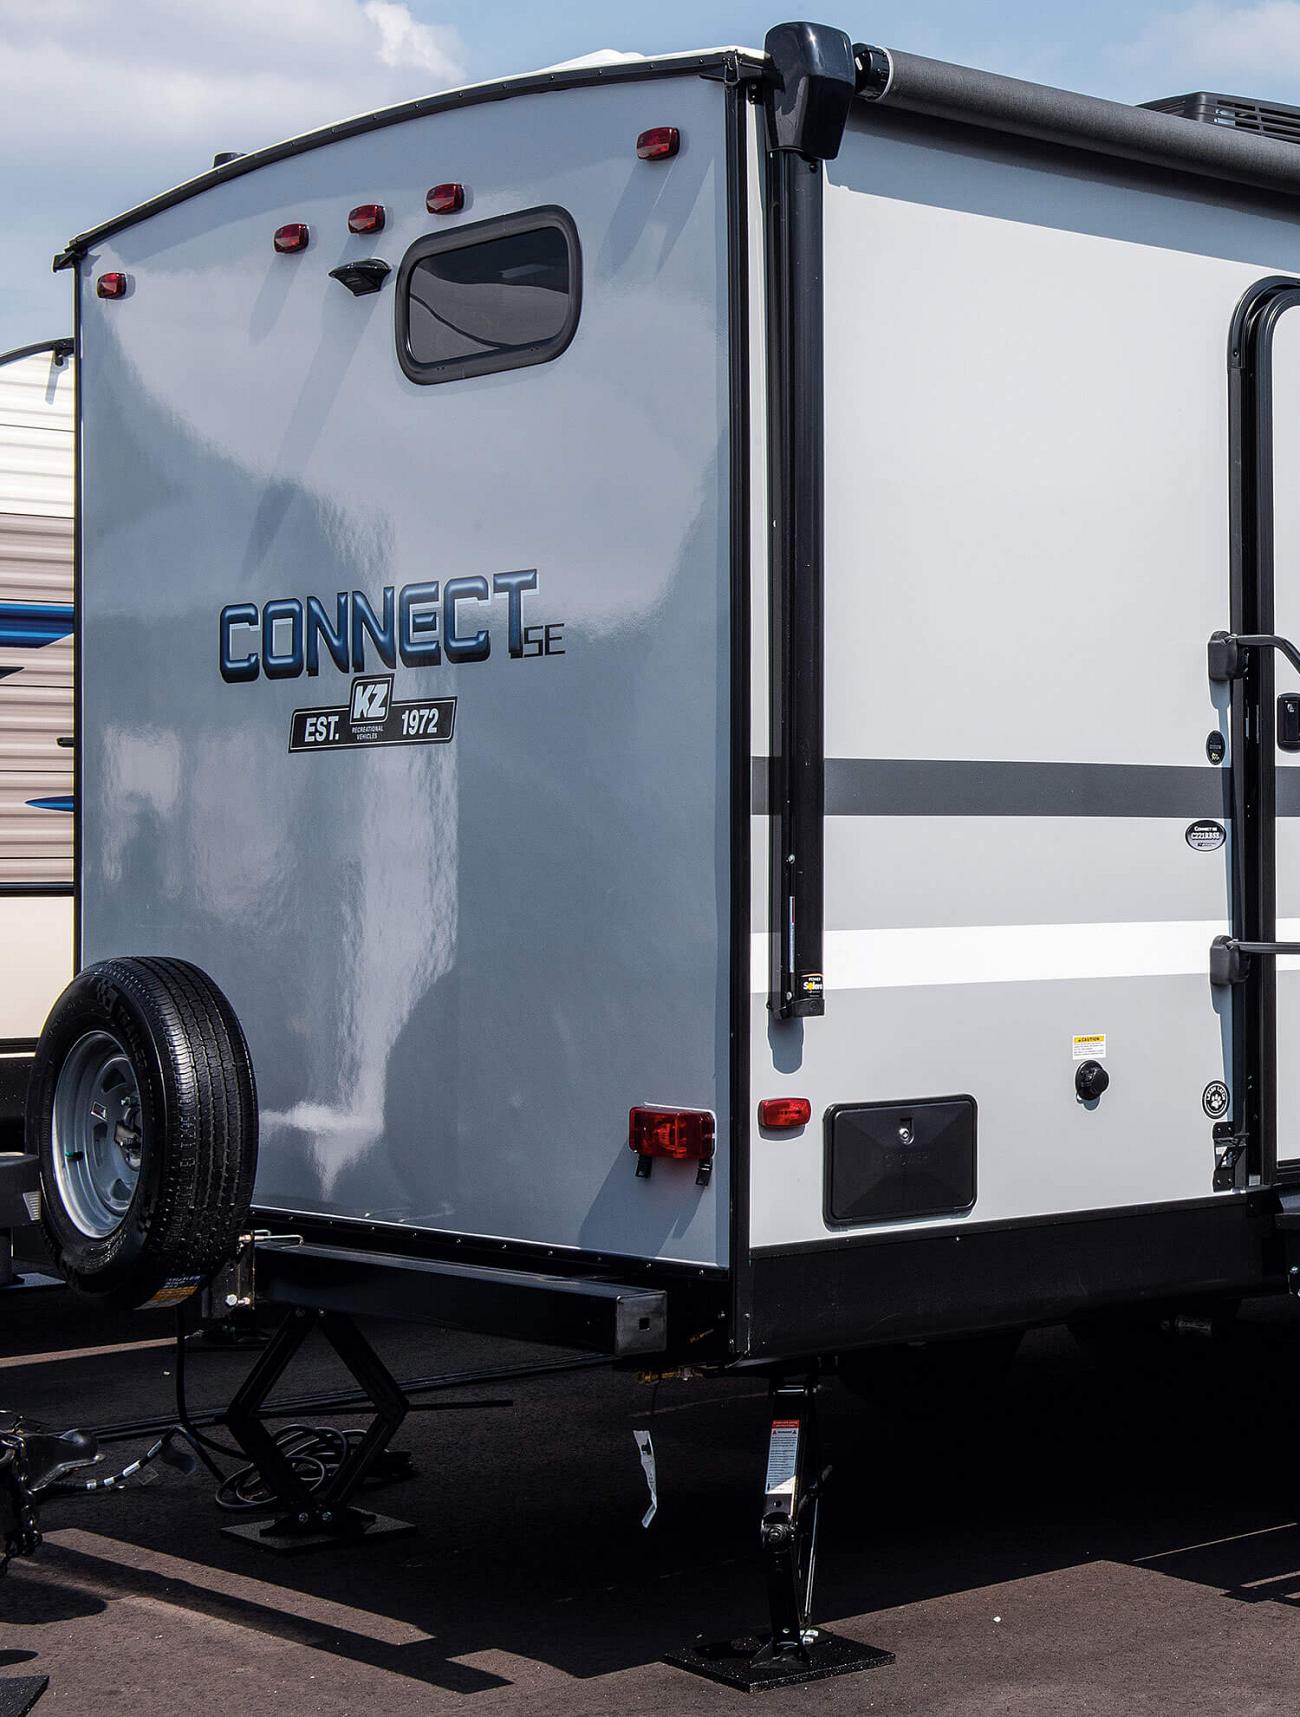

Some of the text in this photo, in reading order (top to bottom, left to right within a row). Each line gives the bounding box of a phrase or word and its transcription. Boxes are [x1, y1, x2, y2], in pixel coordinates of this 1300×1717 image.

[219, 568, 566, 684] CONNECT SE
[353, 683, 390, 720] KZ
[304, 708, 439, 743] EST. 1972
